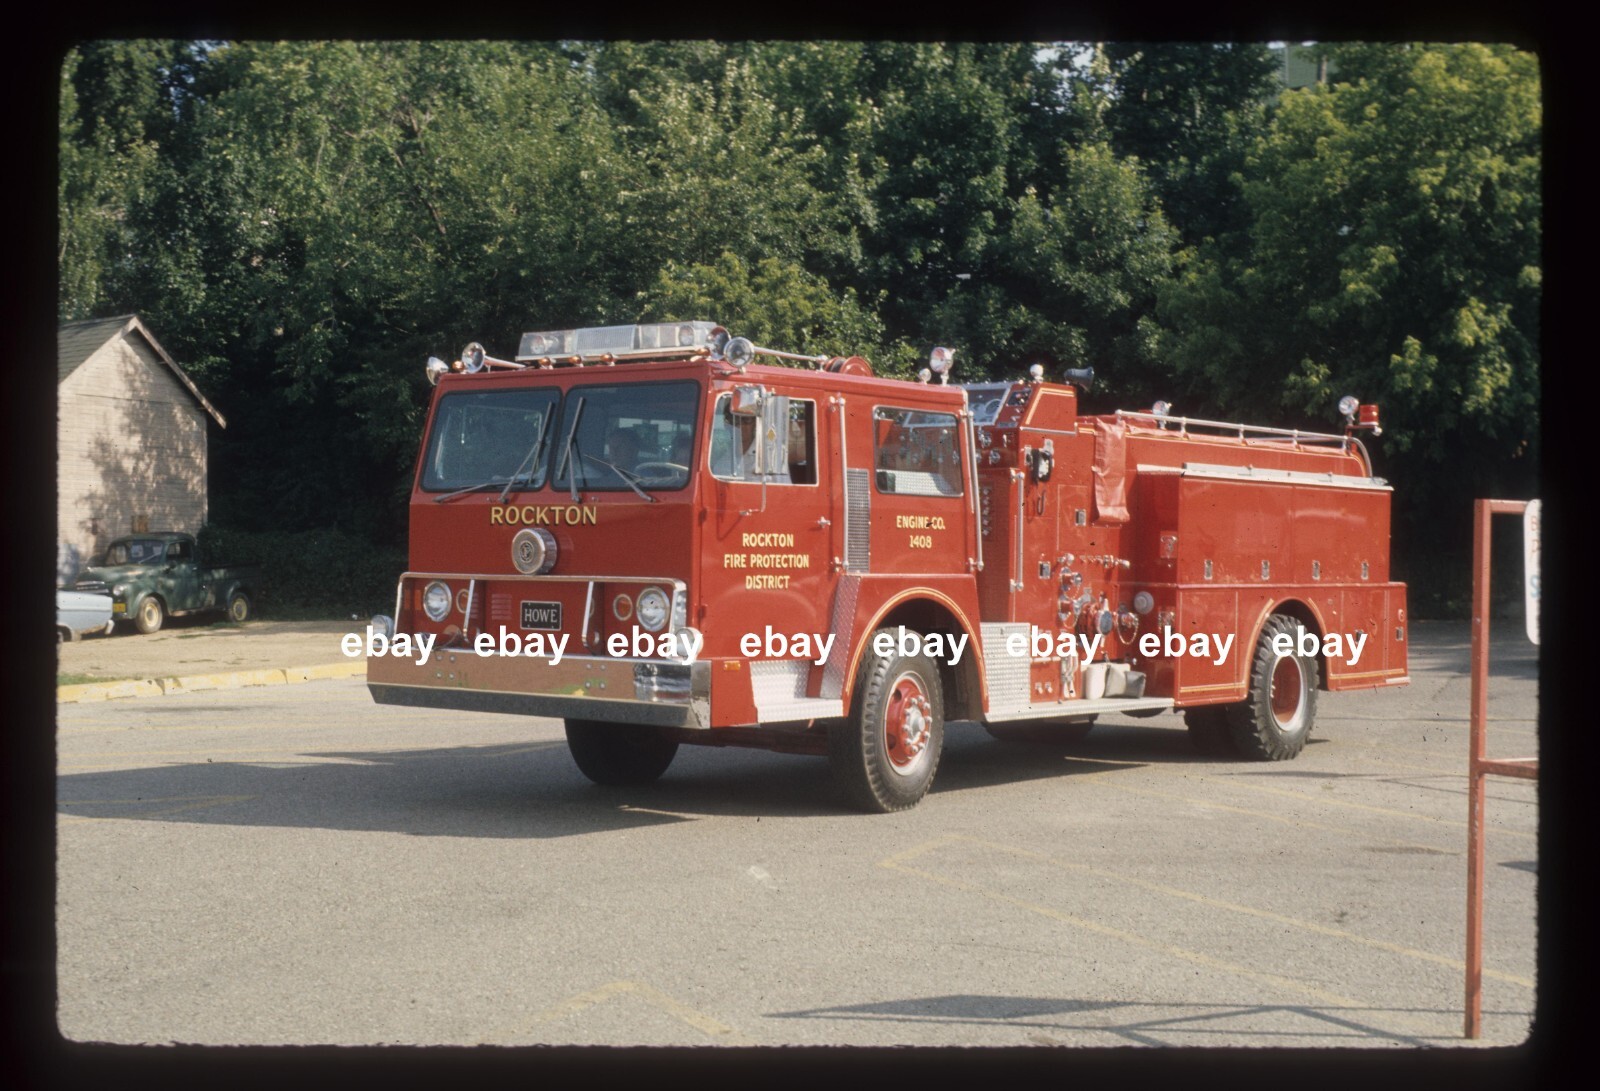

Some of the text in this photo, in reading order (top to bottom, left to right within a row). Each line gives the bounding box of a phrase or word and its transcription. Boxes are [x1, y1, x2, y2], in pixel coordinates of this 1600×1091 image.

[490, 505, 597, 526] ROCKTON
[896, 515, 946, 530] ENGINE CO.
[742, 532, 794, 548] ROCKTON
[909, 534, 932, 549] 1408
[724, 553, 810, 569] FIRE PROTECTION
[745, 575, 790, 590] DISTRICT
[524, 608, 558, 623] HOWE
